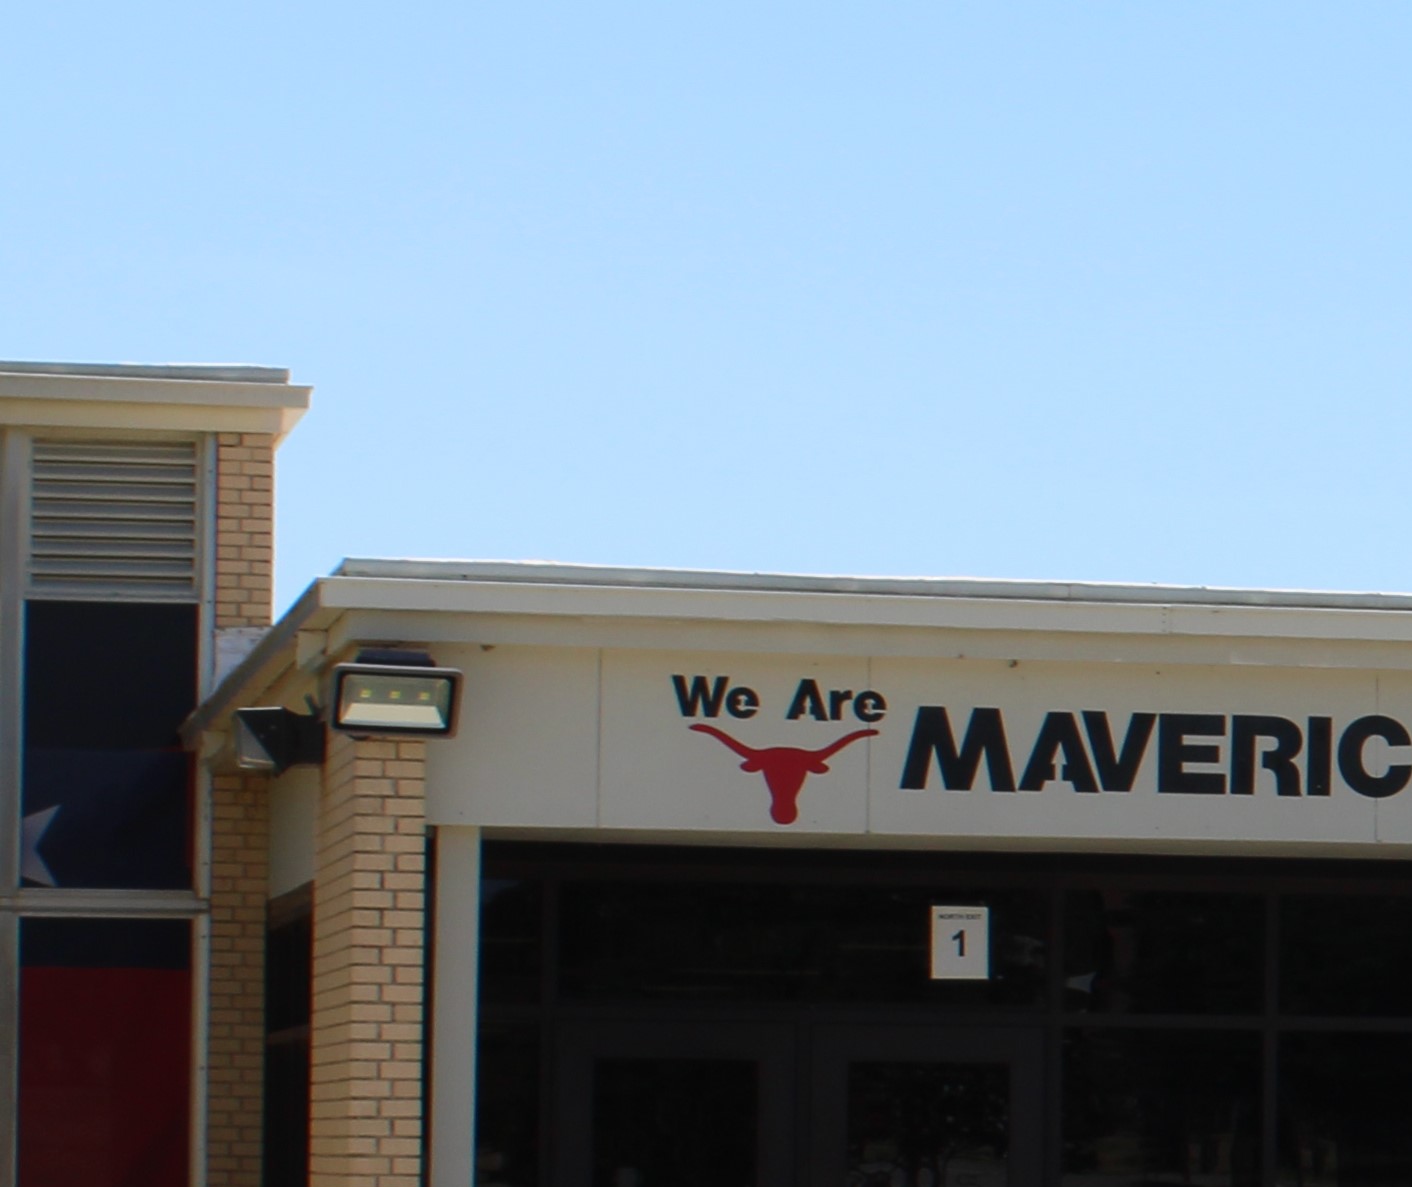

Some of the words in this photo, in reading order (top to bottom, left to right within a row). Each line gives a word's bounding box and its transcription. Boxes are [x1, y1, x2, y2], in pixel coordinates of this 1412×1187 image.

[670, 674, 760, 719] We
[786, 677, 888, 723] Are
[951, 928, 966, 957] 1
